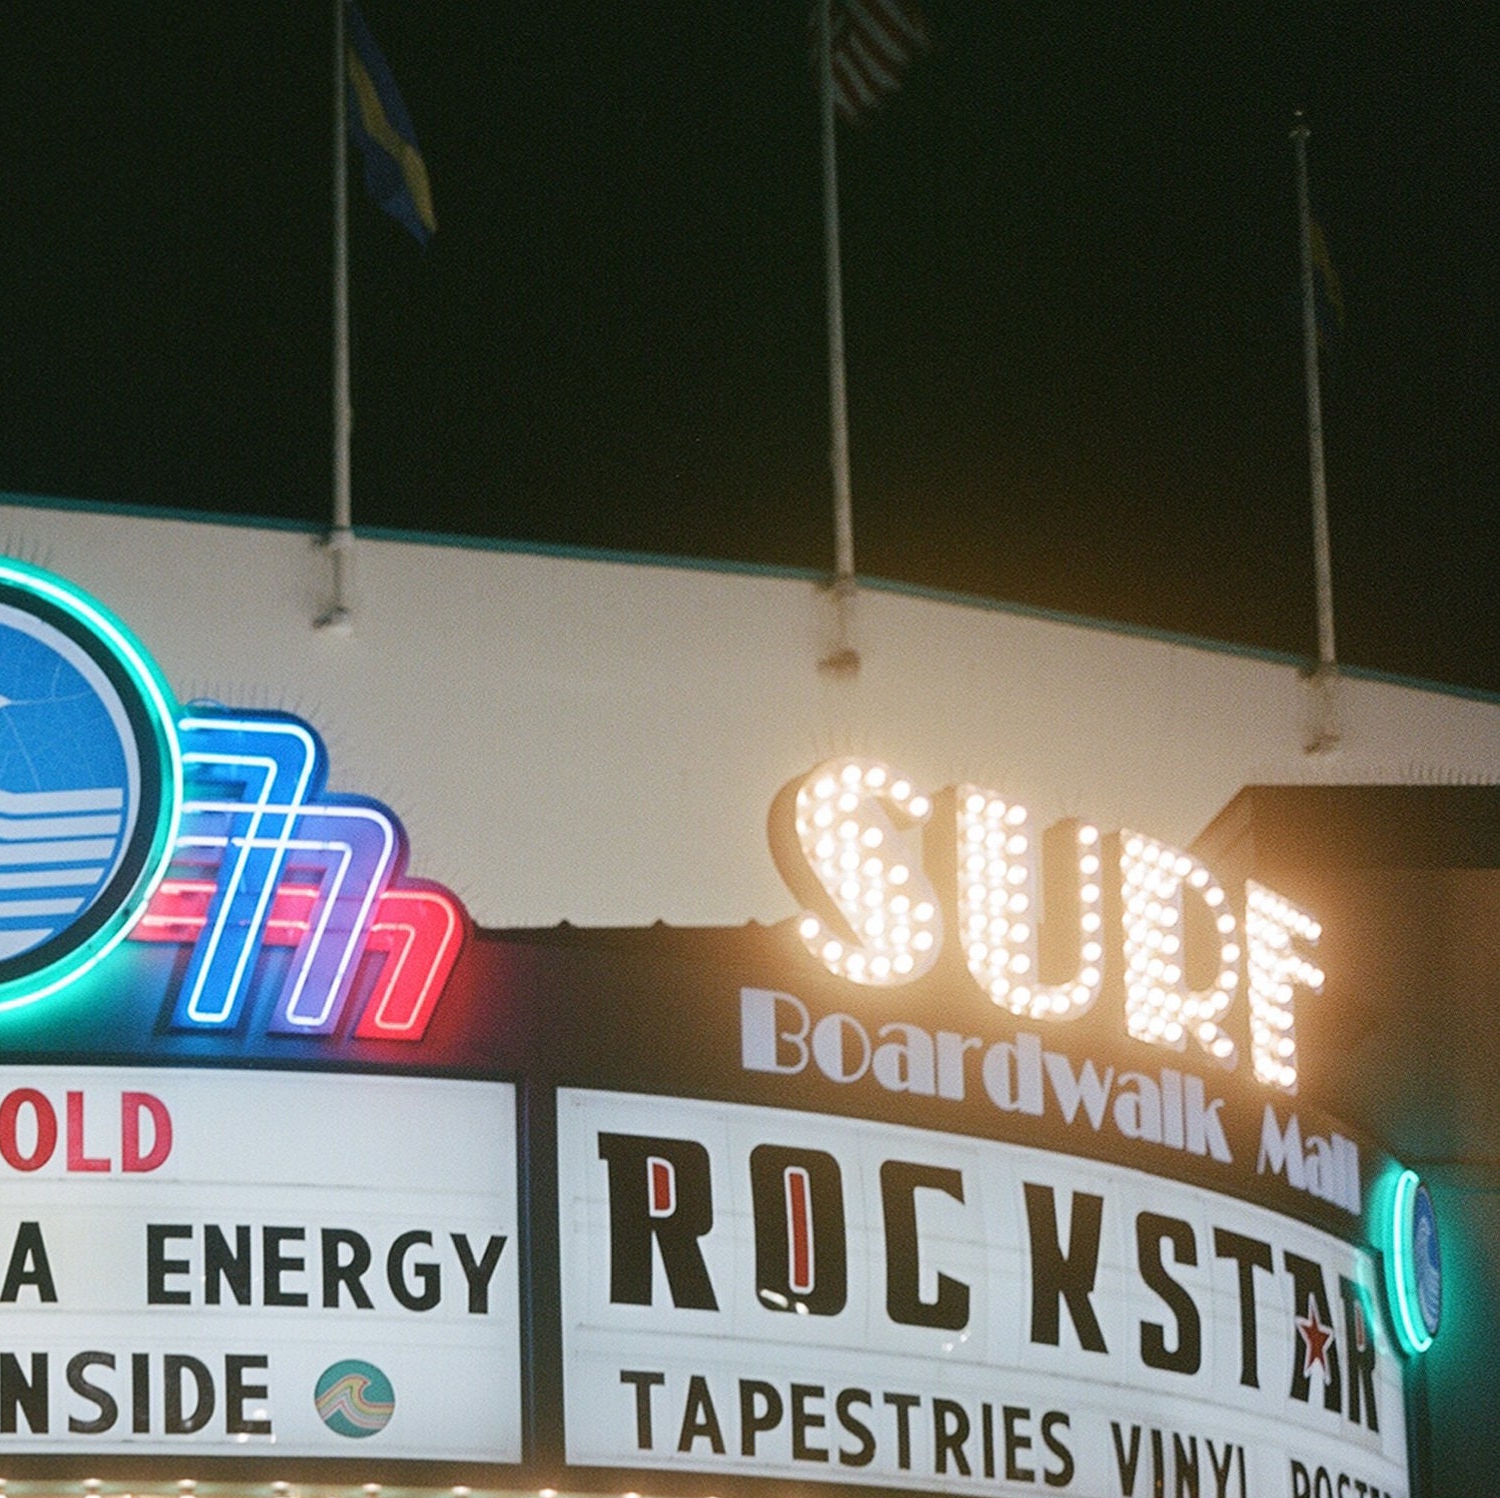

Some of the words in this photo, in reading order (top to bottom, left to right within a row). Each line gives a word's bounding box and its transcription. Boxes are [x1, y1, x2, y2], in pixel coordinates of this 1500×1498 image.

[795, 756, 1323, 1093] SURF
[740, 987, 1232, 1163] Boardwalk
[1258, 1105, 1360, 1216] Mall
[147, 1223, 507, 1314] ENERGY
[621, 1370, 1074, 1489] TAPESTRIES
